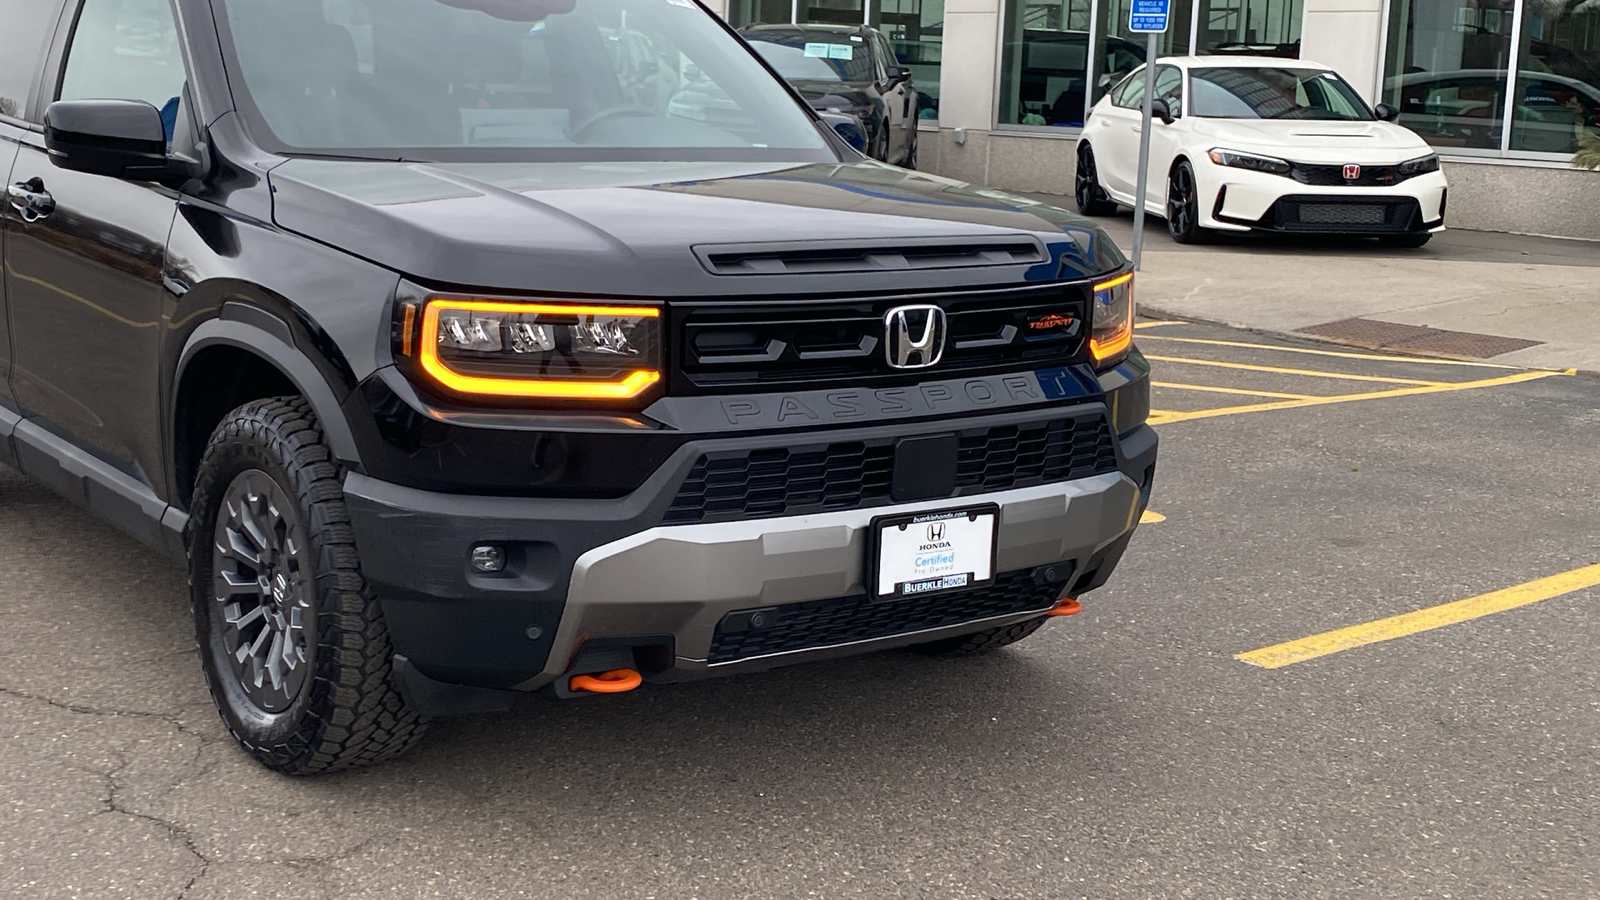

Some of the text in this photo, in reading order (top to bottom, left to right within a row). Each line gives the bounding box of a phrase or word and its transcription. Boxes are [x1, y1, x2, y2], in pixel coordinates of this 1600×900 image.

[720, 371, 1066, 425] PASSPORT
[919, 541, 951, 551] HONDA
[915, 552, 954, 567] Certified
[929, 564, 954, 573] Owned
